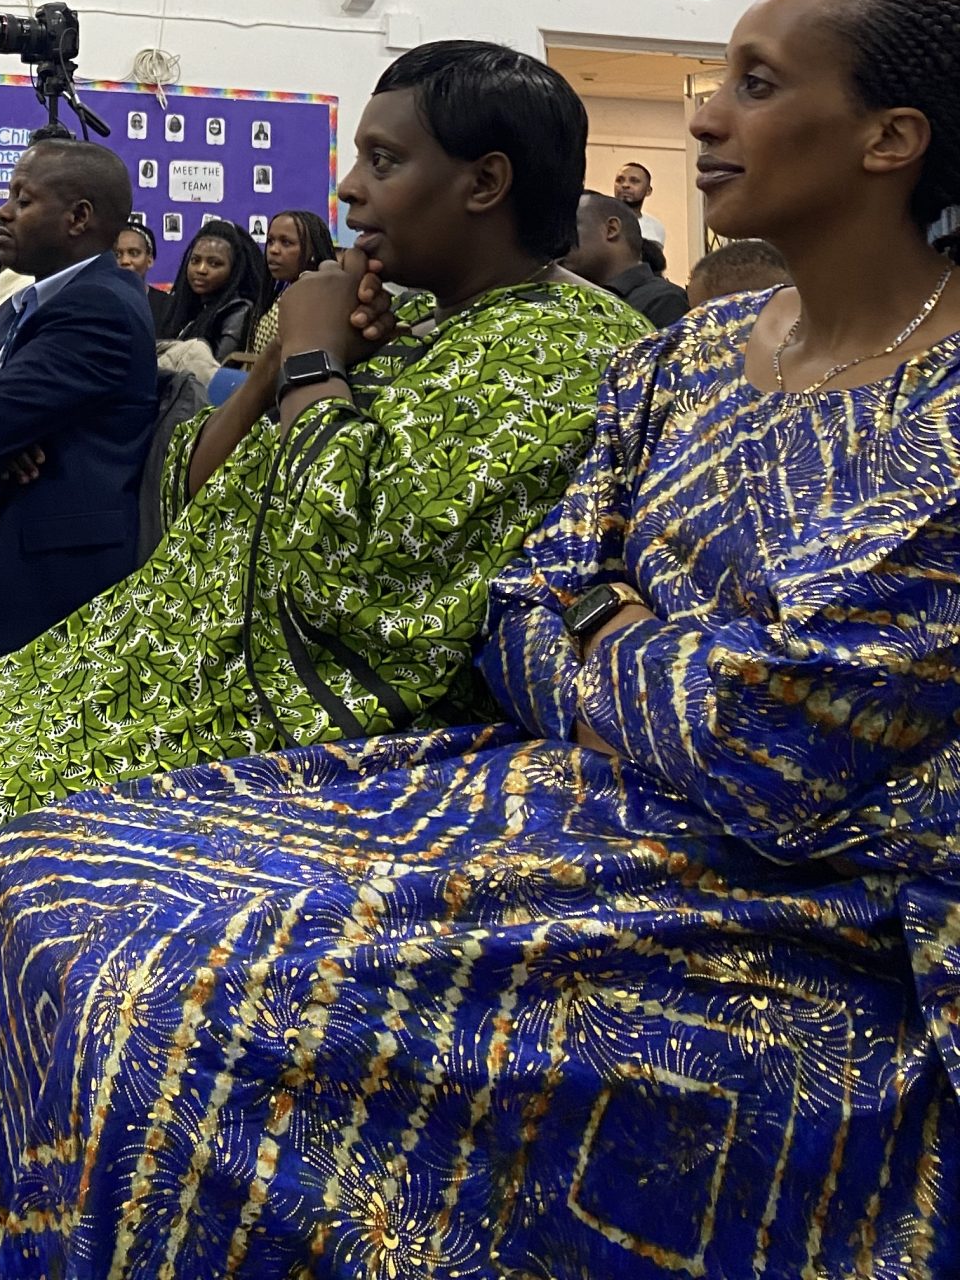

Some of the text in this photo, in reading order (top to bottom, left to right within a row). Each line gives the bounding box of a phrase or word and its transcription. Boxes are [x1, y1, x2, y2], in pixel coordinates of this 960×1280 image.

[173, 166, 220, 176] MEET THE
[182, 181, 211, 192] TEAM!
